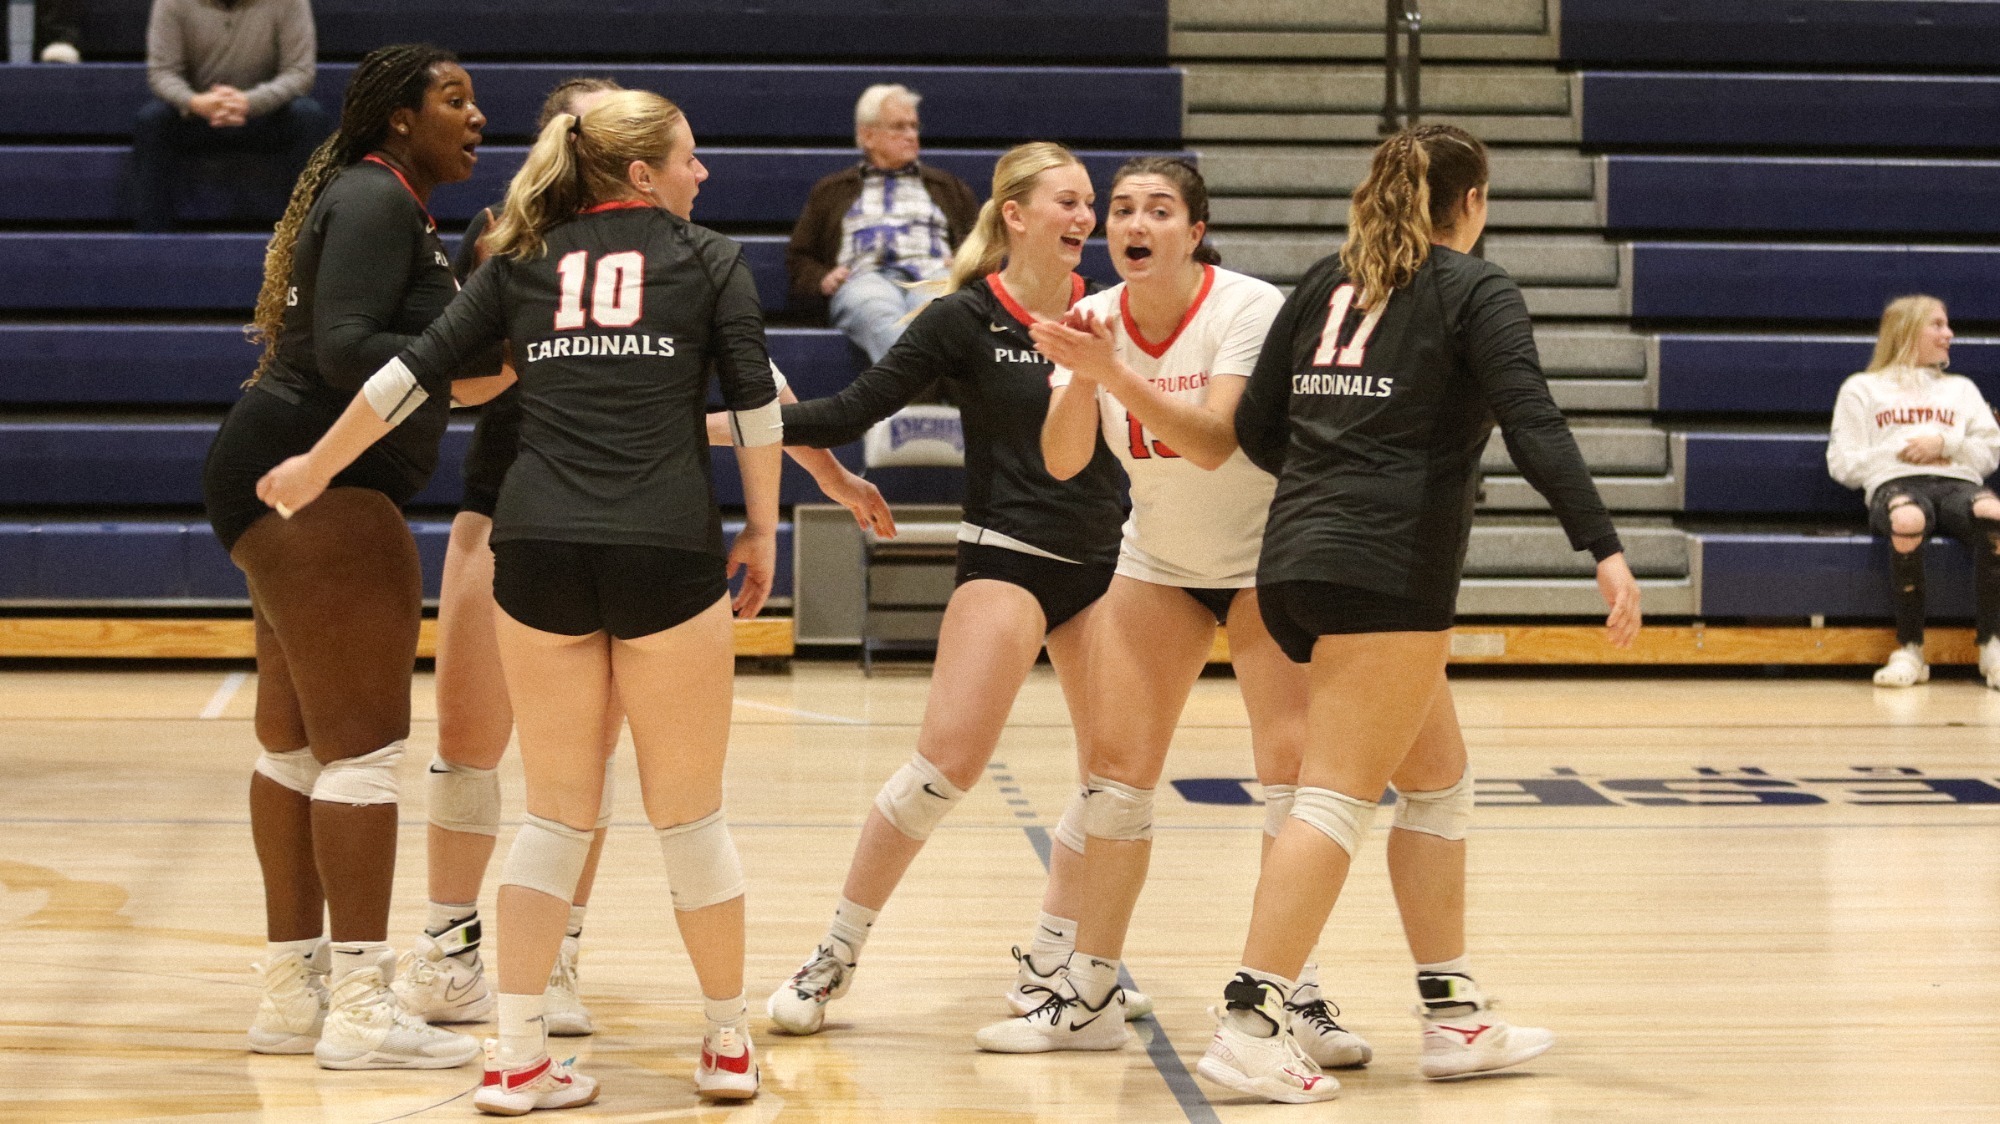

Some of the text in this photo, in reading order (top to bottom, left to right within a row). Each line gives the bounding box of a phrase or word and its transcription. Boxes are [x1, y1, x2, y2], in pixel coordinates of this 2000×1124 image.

[554, 249, 645, 331] 10
[1311, 283, 1395, 367] 17
[527, 334, 675, 363] CARDINALS
[1147, 369, 1210, 392] BURGH
[1292, 374, 1394, 397] CARDINALS
[1875, 408, 1954, 428] VOLLEYBALL
[1125, 410, 1182, 459] 1
